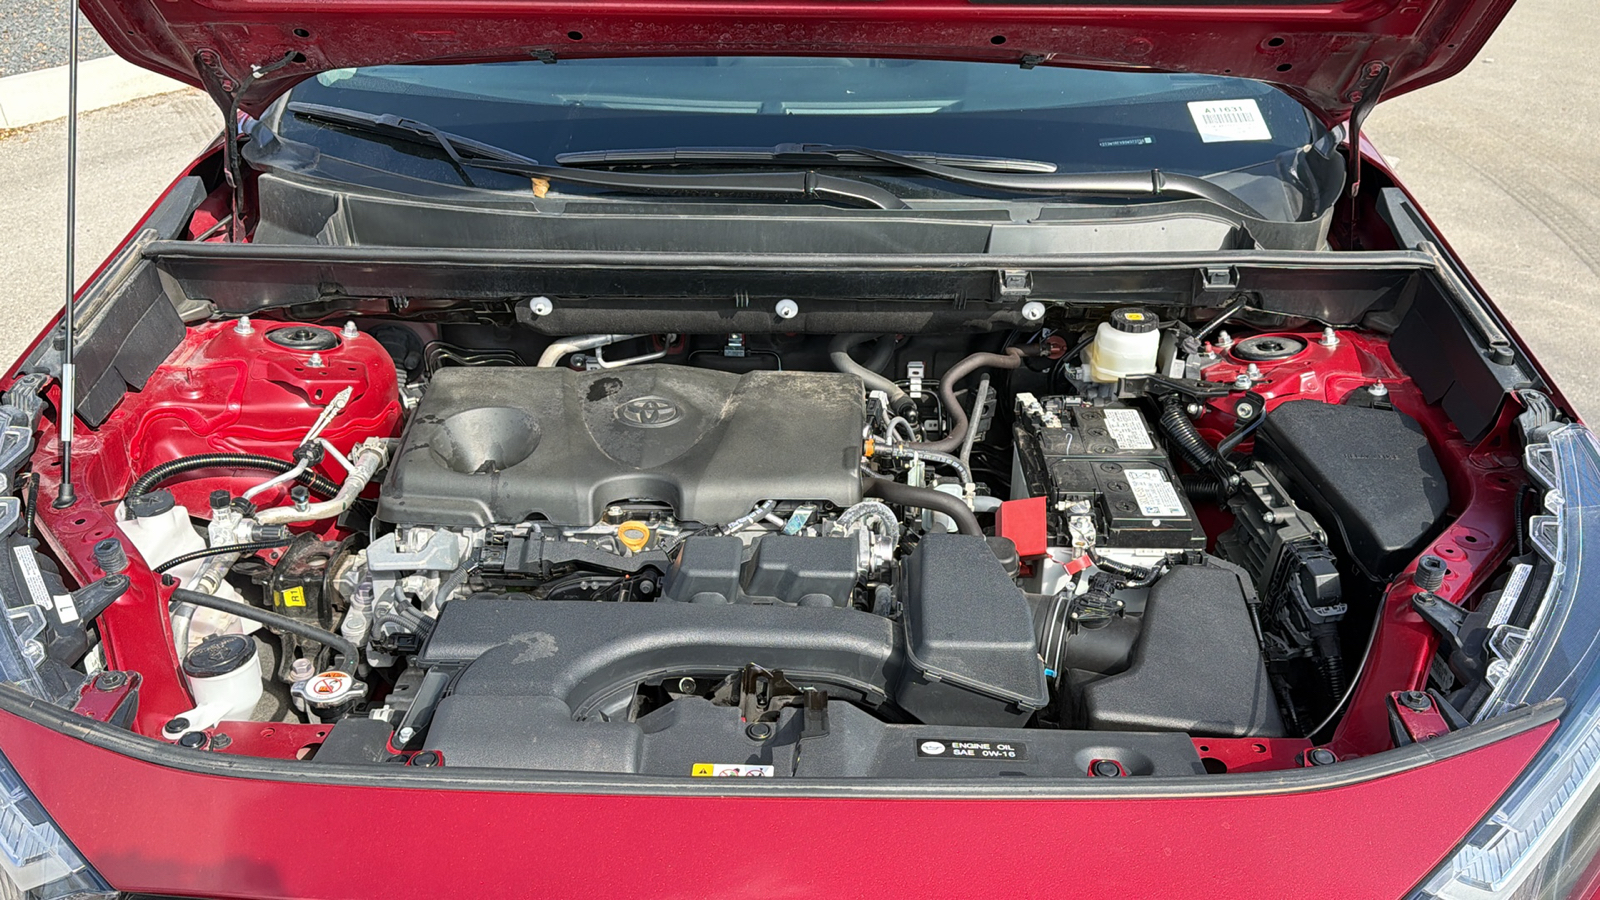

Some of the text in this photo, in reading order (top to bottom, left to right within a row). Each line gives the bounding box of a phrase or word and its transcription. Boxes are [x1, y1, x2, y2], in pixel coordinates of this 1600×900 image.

[1205, 106, 1243, 114] A11631
[291, 590, 300, 602] R1
[951, 742, 1015, 751] ENGINE OIL
[982, 750, 1016, 758] 0W-16
